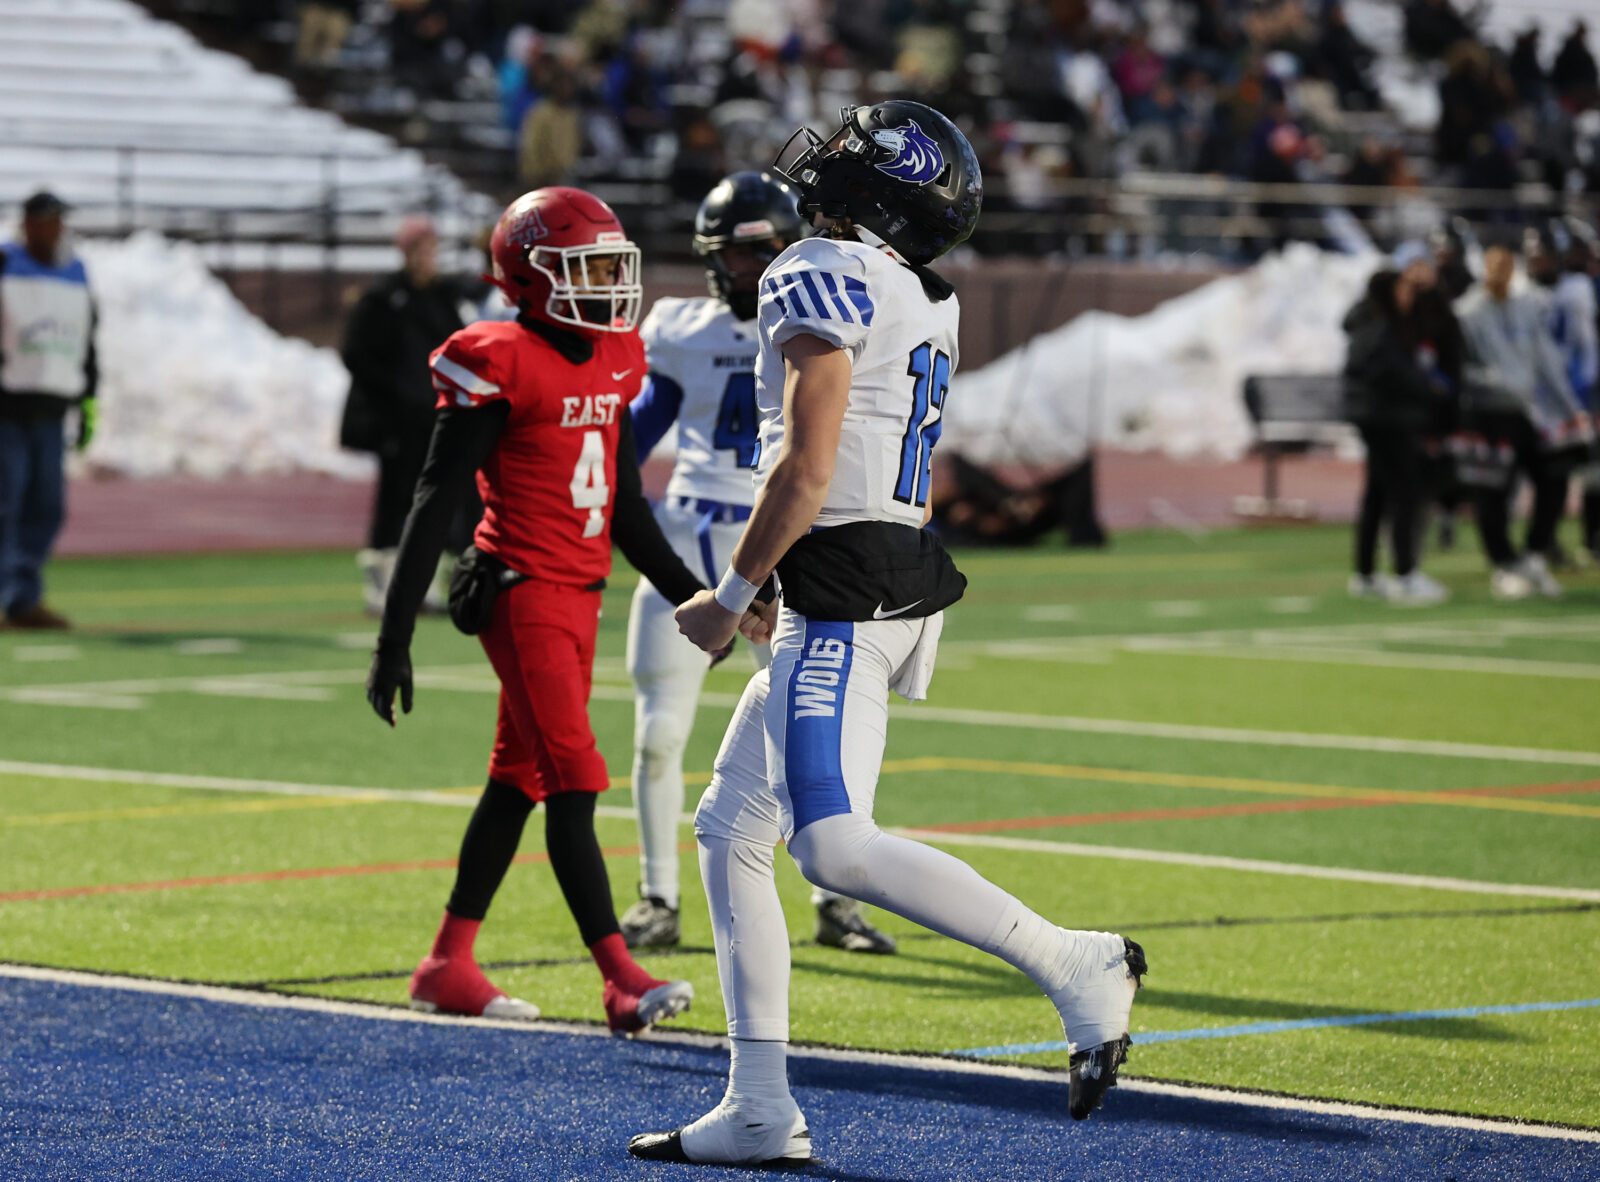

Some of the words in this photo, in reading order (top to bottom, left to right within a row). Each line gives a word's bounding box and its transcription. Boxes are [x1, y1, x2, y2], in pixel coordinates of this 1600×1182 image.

[713, 355, 755, 368] WOLVE
[560, 393, 621, 427] EAST
[713, 372, 758, 468] 4
[892, 340, 949, 508] 12
[569, 431, 609, 538] 4
